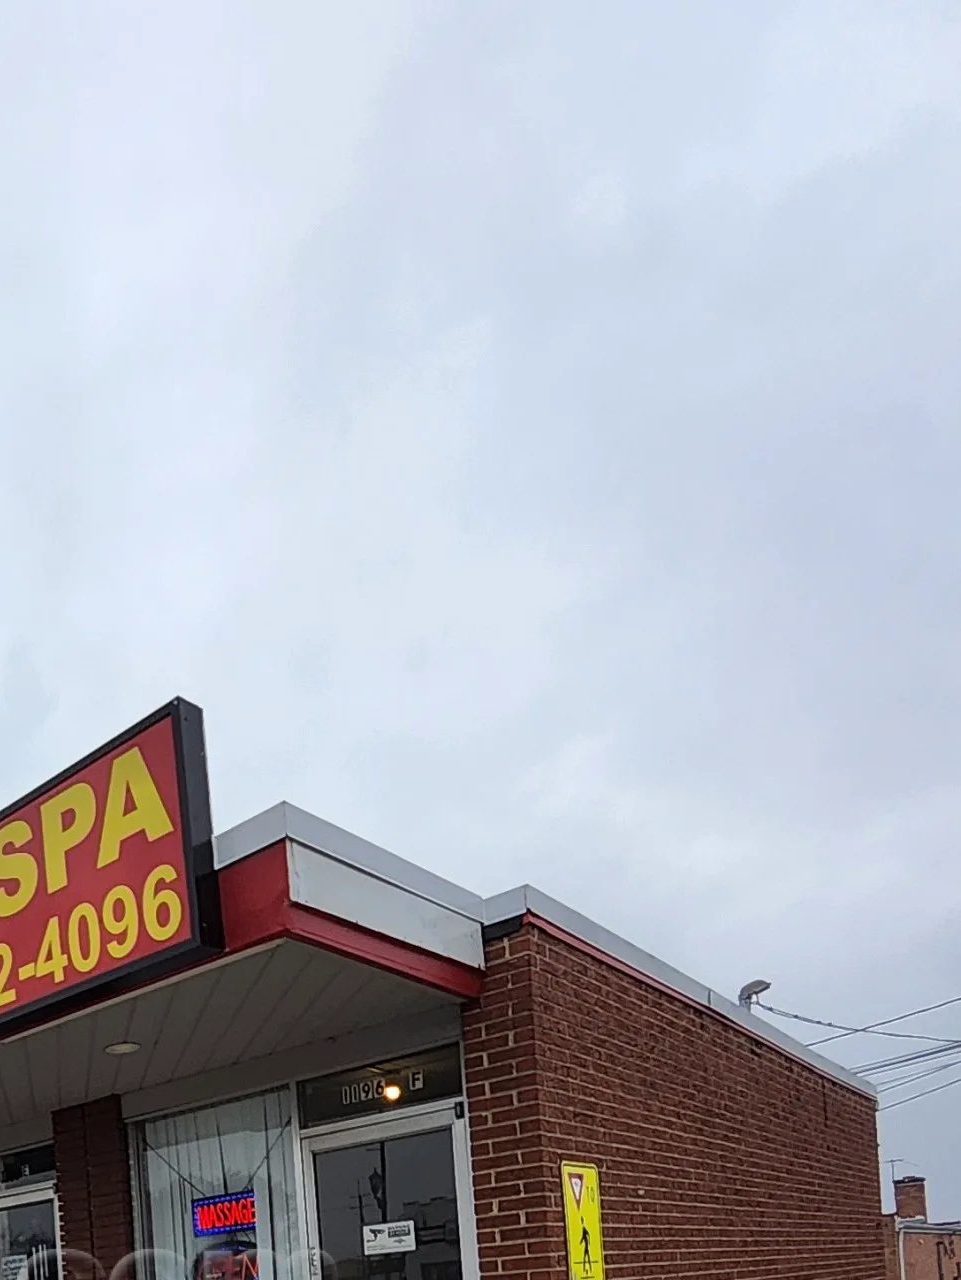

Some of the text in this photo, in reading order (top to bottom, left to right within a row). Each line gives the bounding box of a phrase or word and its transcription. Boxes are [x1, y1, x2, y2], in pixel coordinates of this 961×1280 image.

[342, 1070, 423, 1104] 1196 F
[198, 1198, 257, 1230] MASSAGE
